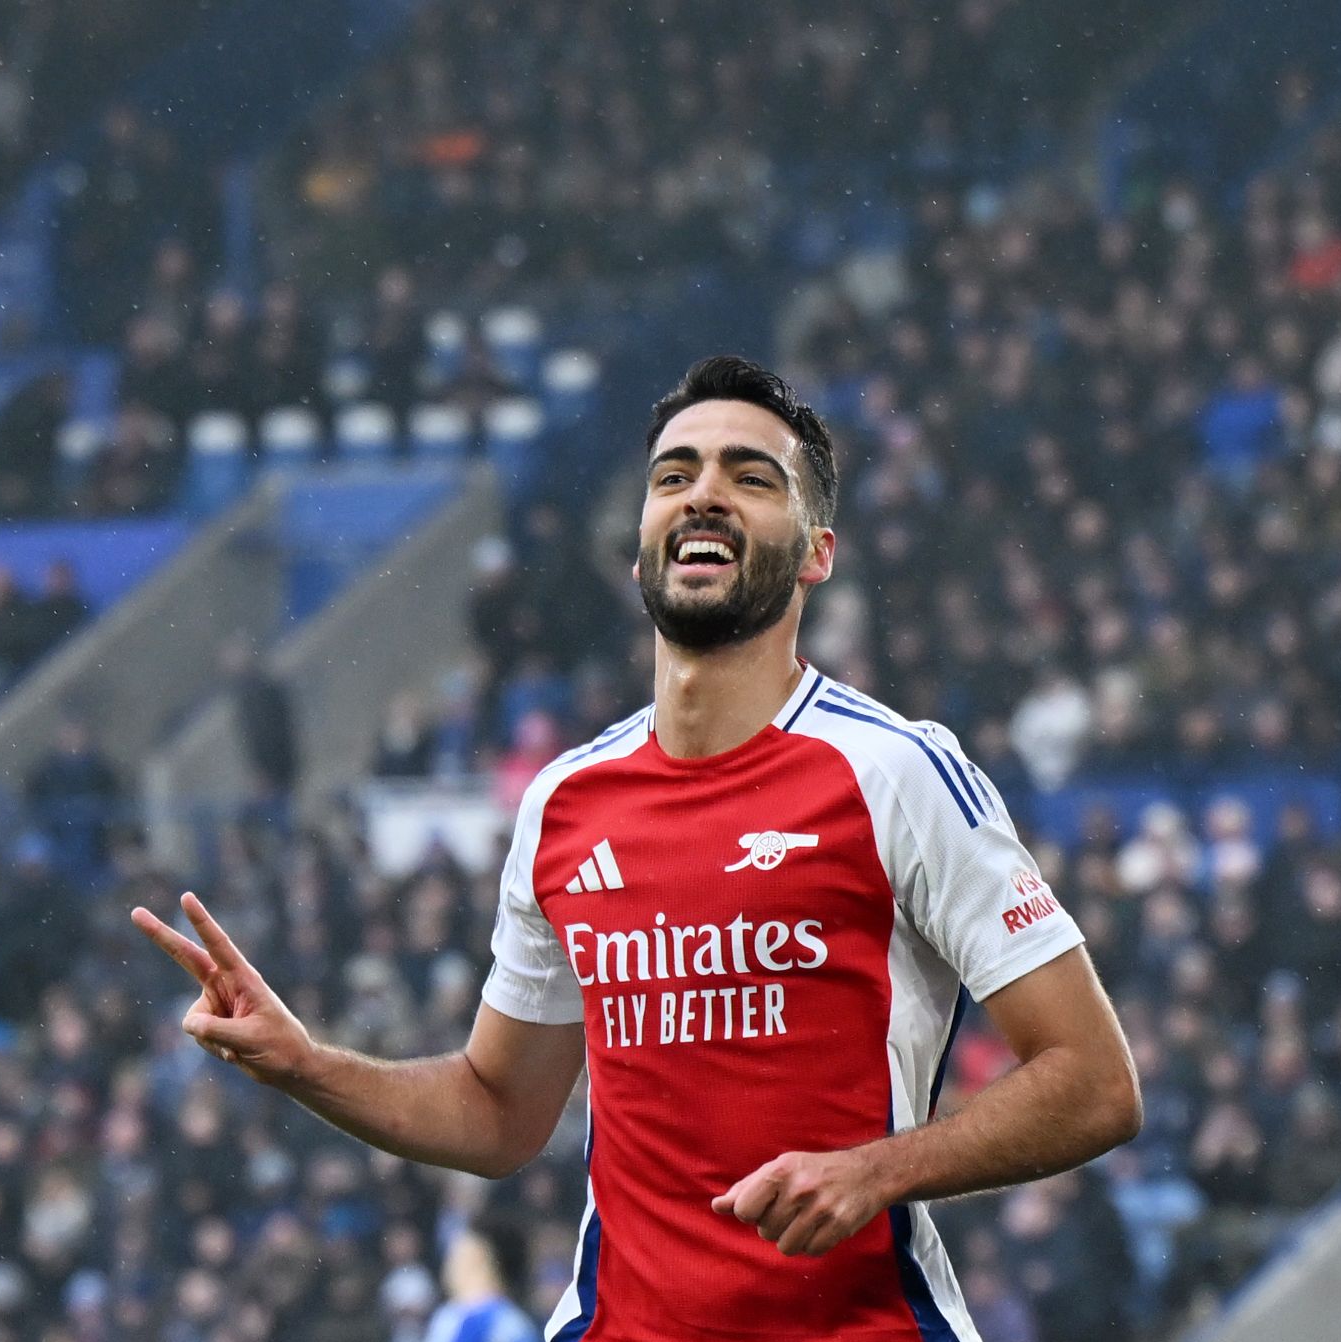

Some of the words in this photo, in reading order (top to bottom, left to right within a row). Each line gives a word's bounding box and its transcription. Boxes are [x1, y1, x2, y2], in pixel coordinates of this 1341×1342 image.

[564, 911, 829, 987] Emirates
[602, 993, 647, 1048] FLY
[659, 982, 787, 1045] BETTER
